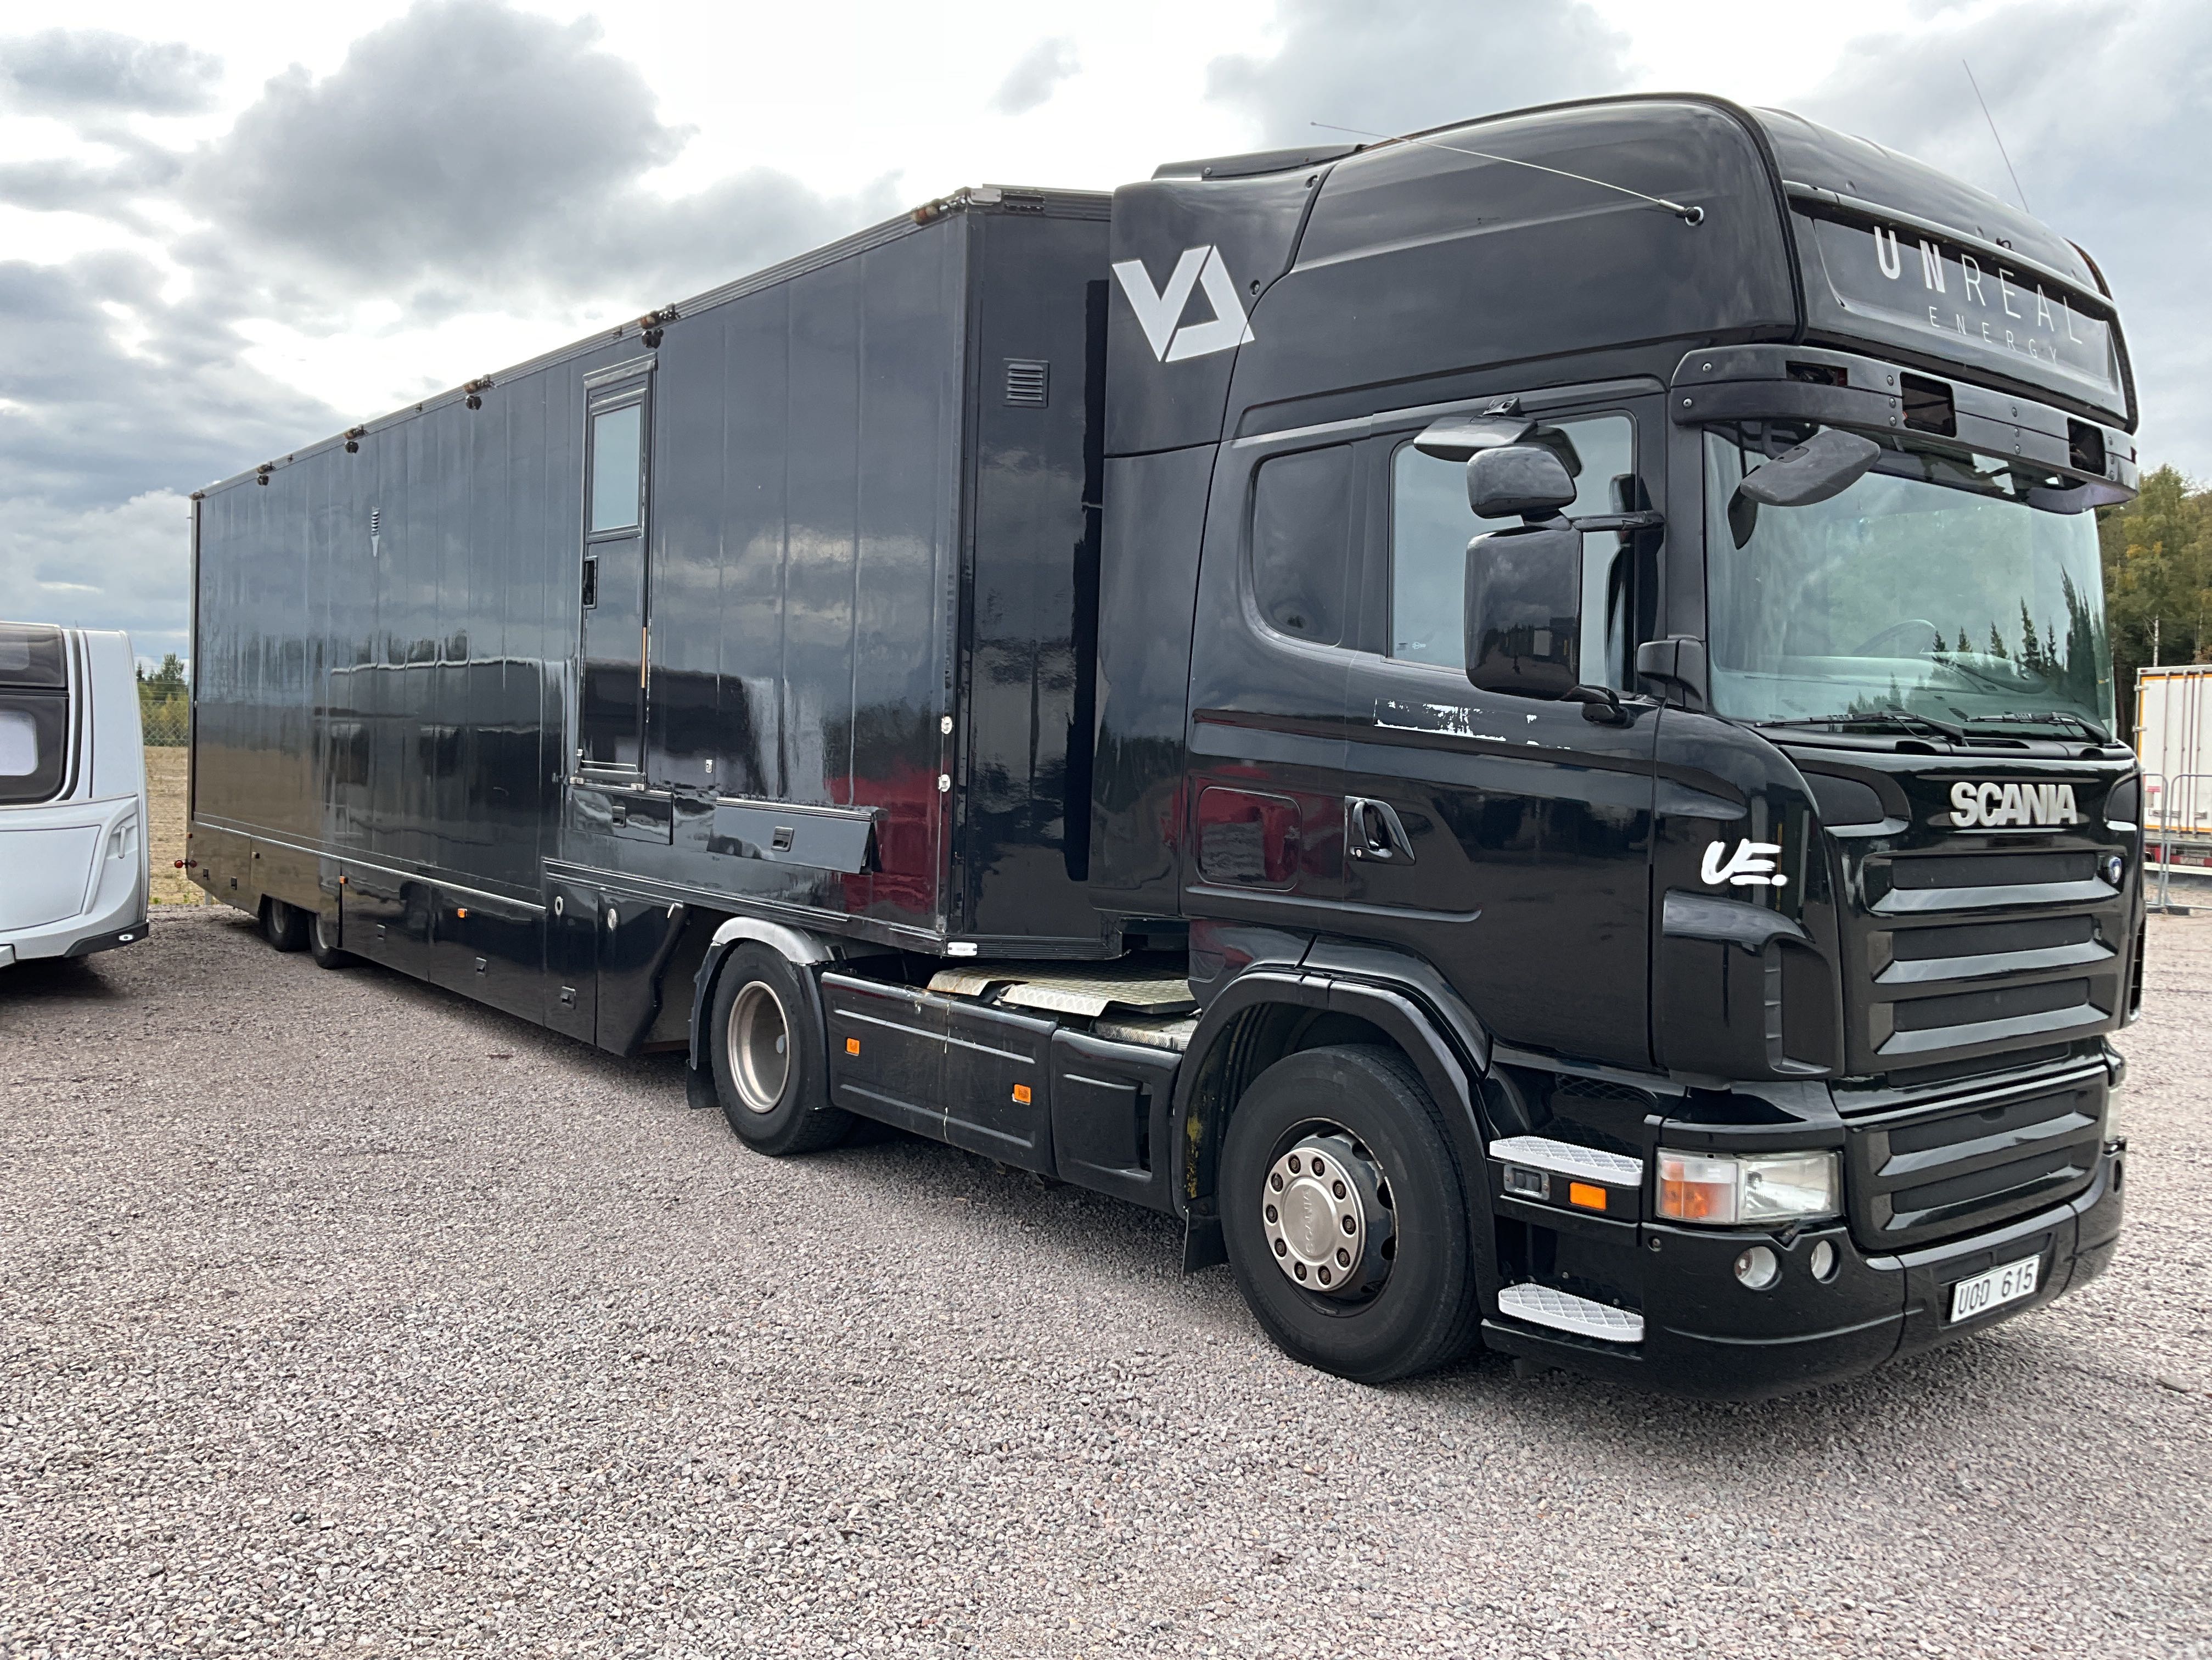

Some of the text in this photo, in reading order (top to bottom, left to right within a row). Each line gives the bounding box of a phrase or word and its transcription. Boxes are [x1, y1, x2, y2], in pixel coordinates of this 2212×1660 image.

[1873, 226, 2083, 345] UNREAL
[1928, 305, 2059, 364] ENERGY
[1949, 781, 2078, 828] SCANIA
[2001, 1263, 2034, 1298] 615
